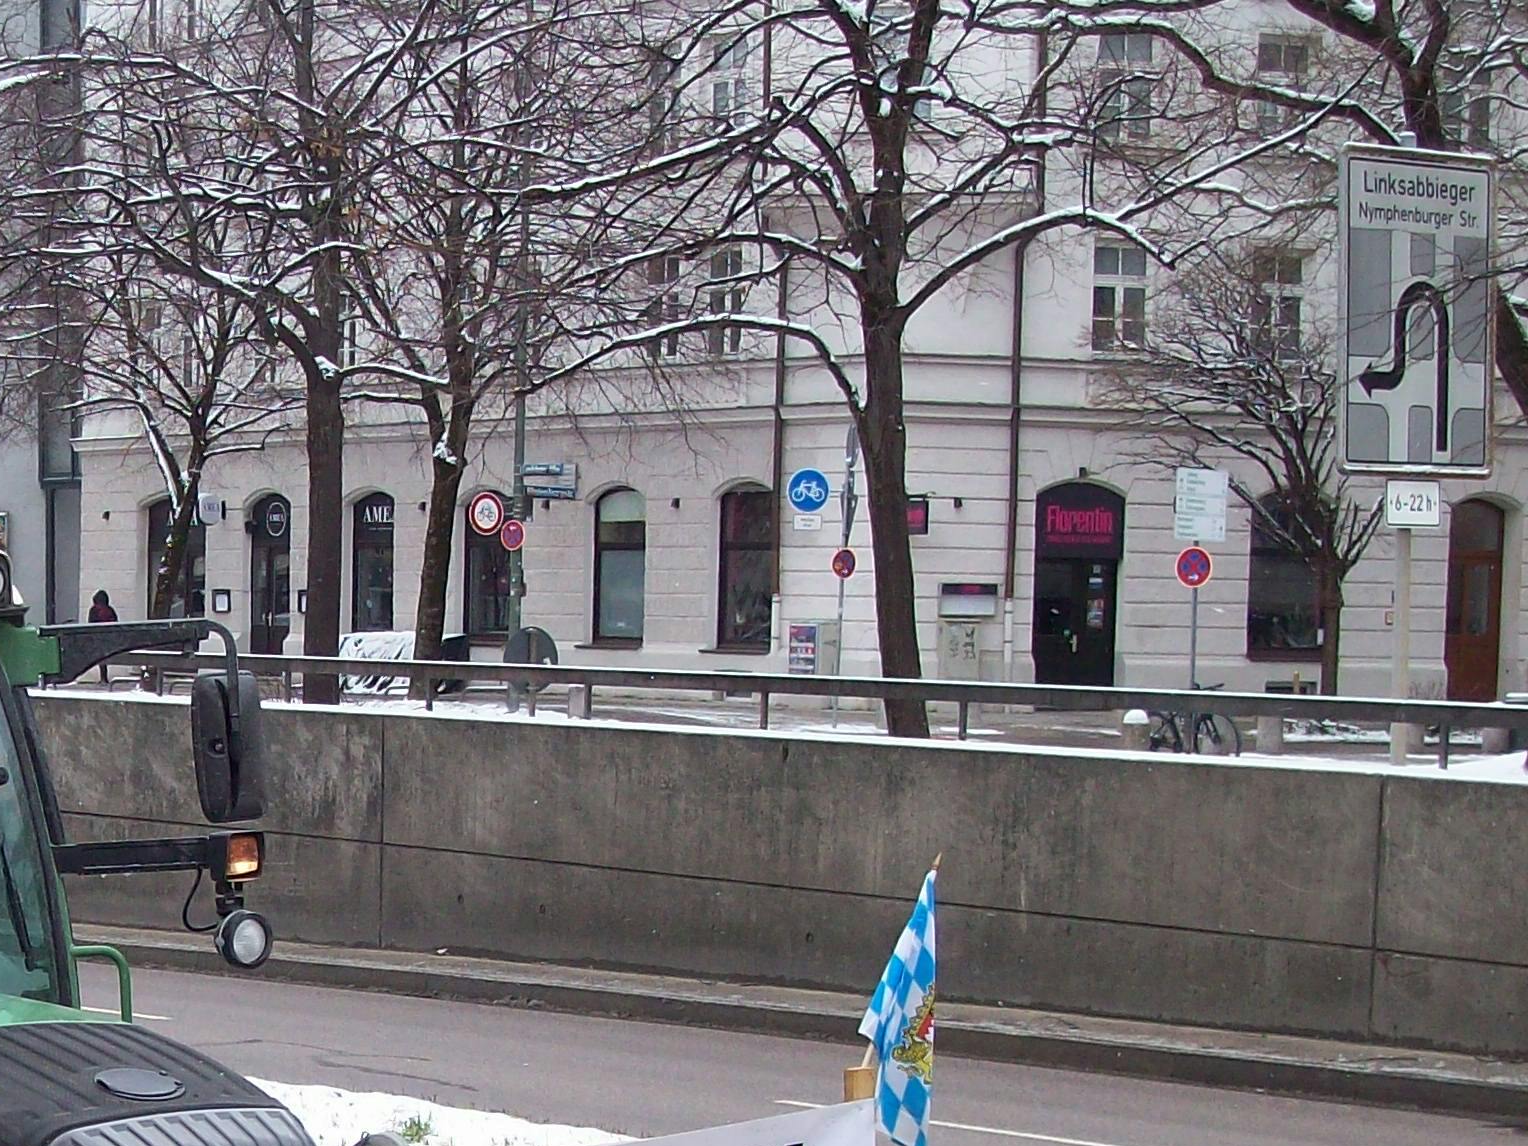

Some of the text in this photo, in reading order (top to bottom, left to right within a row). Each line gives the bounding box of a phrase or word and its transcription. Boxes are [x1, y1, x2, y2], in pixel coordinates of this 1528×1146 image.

[1363, 170, 1475, 206] Linksabbieger
[1358, 201, 1480, 230] Nymphenburger Str.
[363, 505, 393, 523] AME
[1394, 492, 1423, 512] 6-22
[1047, 505, 1113, 533] Florentin
